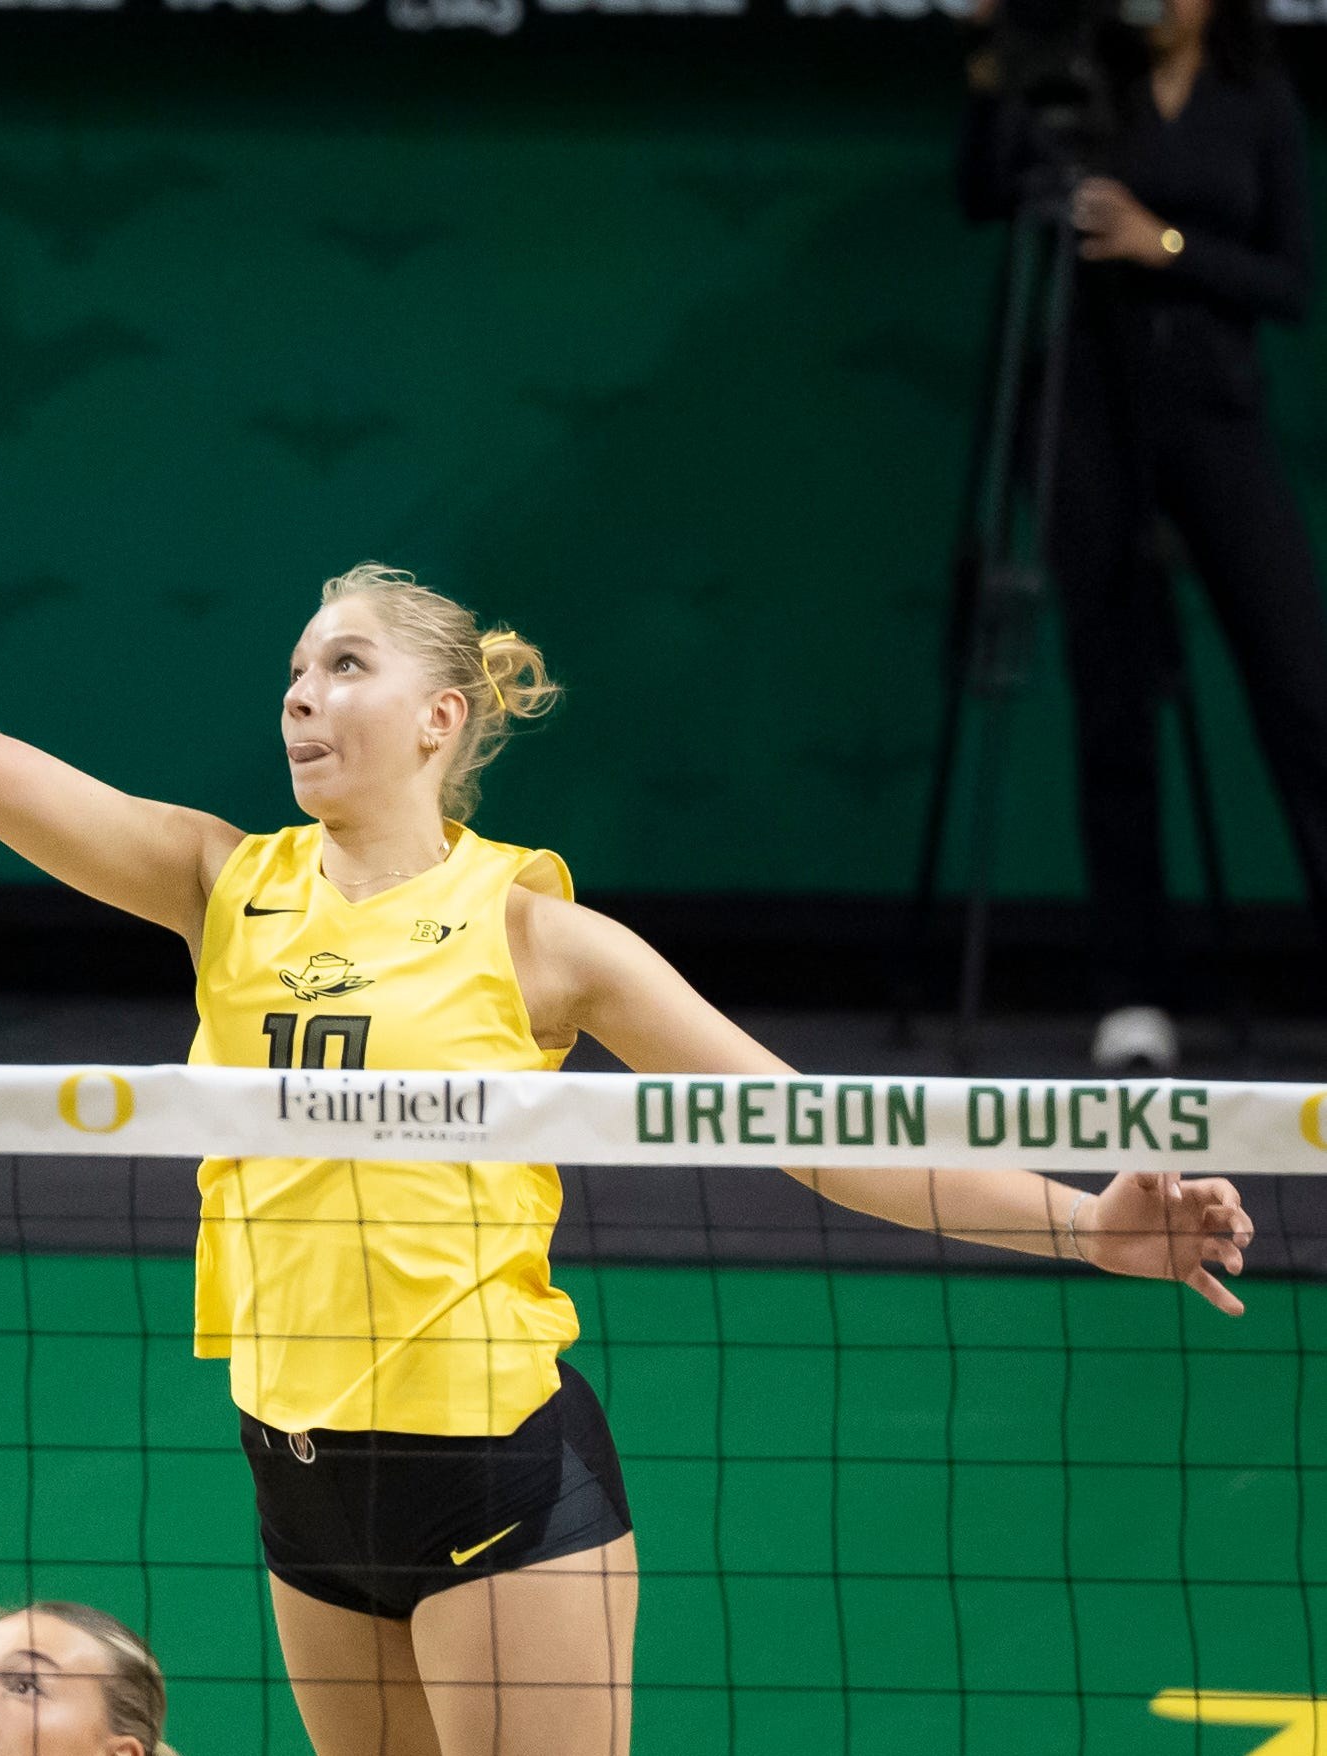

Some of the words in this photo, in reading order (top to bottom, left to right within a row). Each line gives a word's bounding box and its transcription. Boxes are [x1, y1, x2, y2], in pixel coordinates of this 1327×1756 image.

[278, 1075, 488, 1126] Fairfield
[637, 1081, 926, 1146] OREGON
[968, 1086, 1210, 1151] DUCKS
